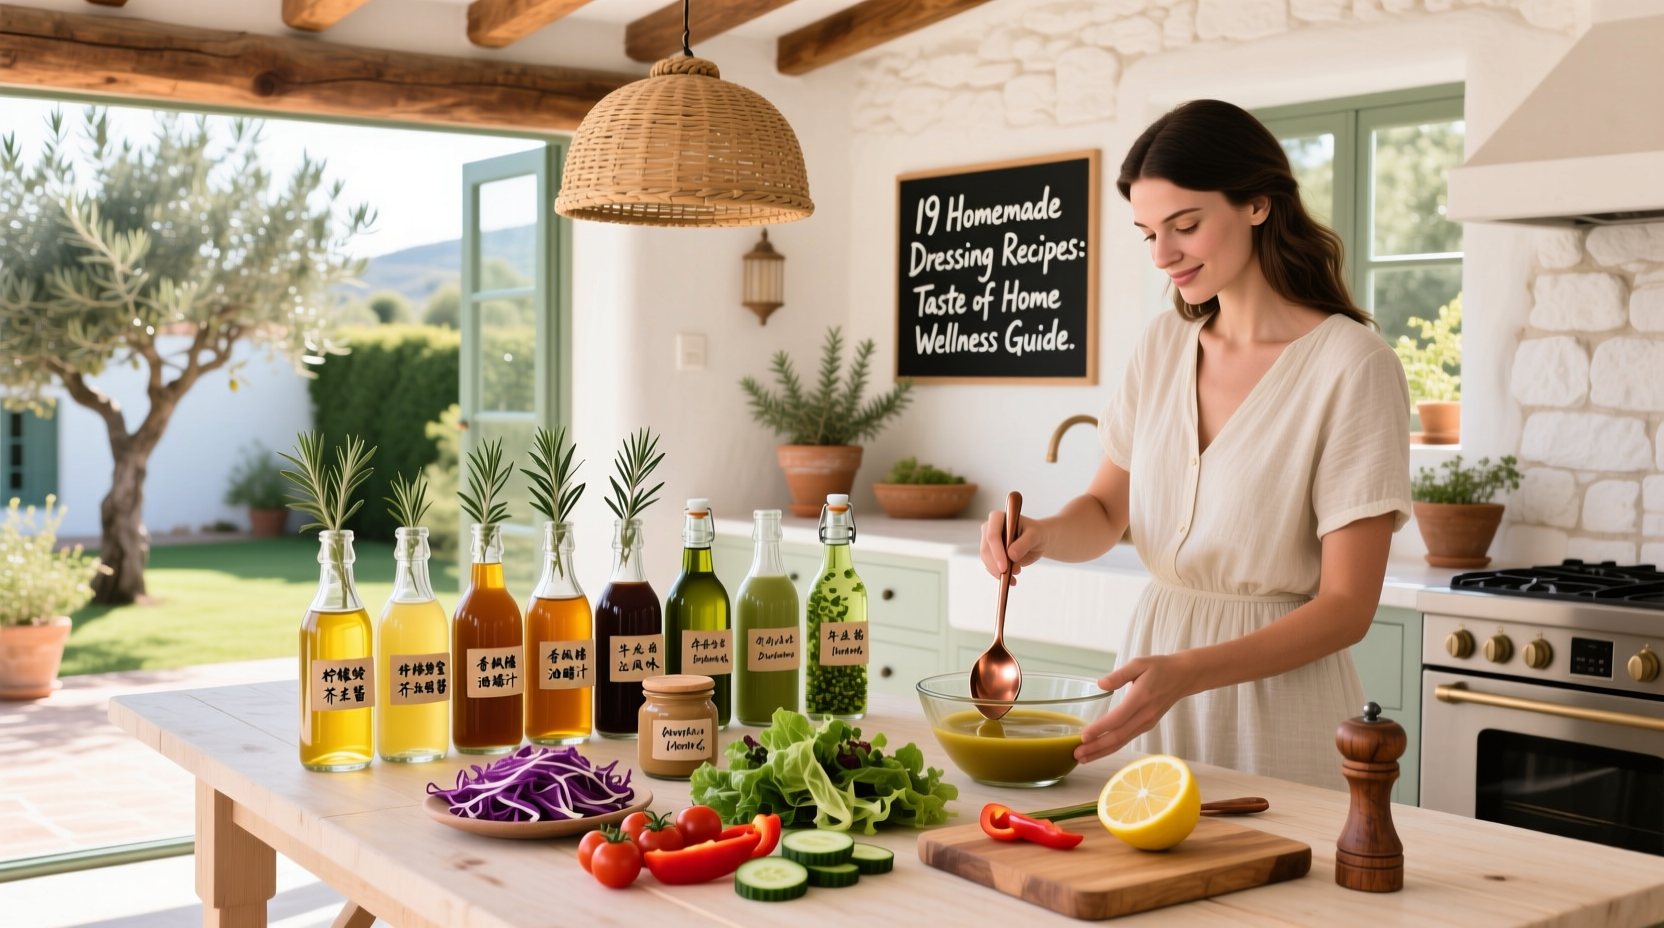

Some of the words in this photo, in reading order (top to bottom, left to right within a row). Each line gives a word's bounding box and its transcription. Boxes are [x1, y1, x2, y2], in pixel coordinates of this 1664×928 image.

[915, 194, 941, 236] 19
[945, 185, 1062, 232] Homemade
[908, 241, 994, 283] Dressing
[1001, 231, 1086, 275] Recipes:
[912, 283, 967, 318] Taste
[972, 281, 996, 321] of
[1001, 279, 1062, 313] Home
[915, 321, 998, 355] Wellness
[1004, 318, 1075, 356] Guide.
